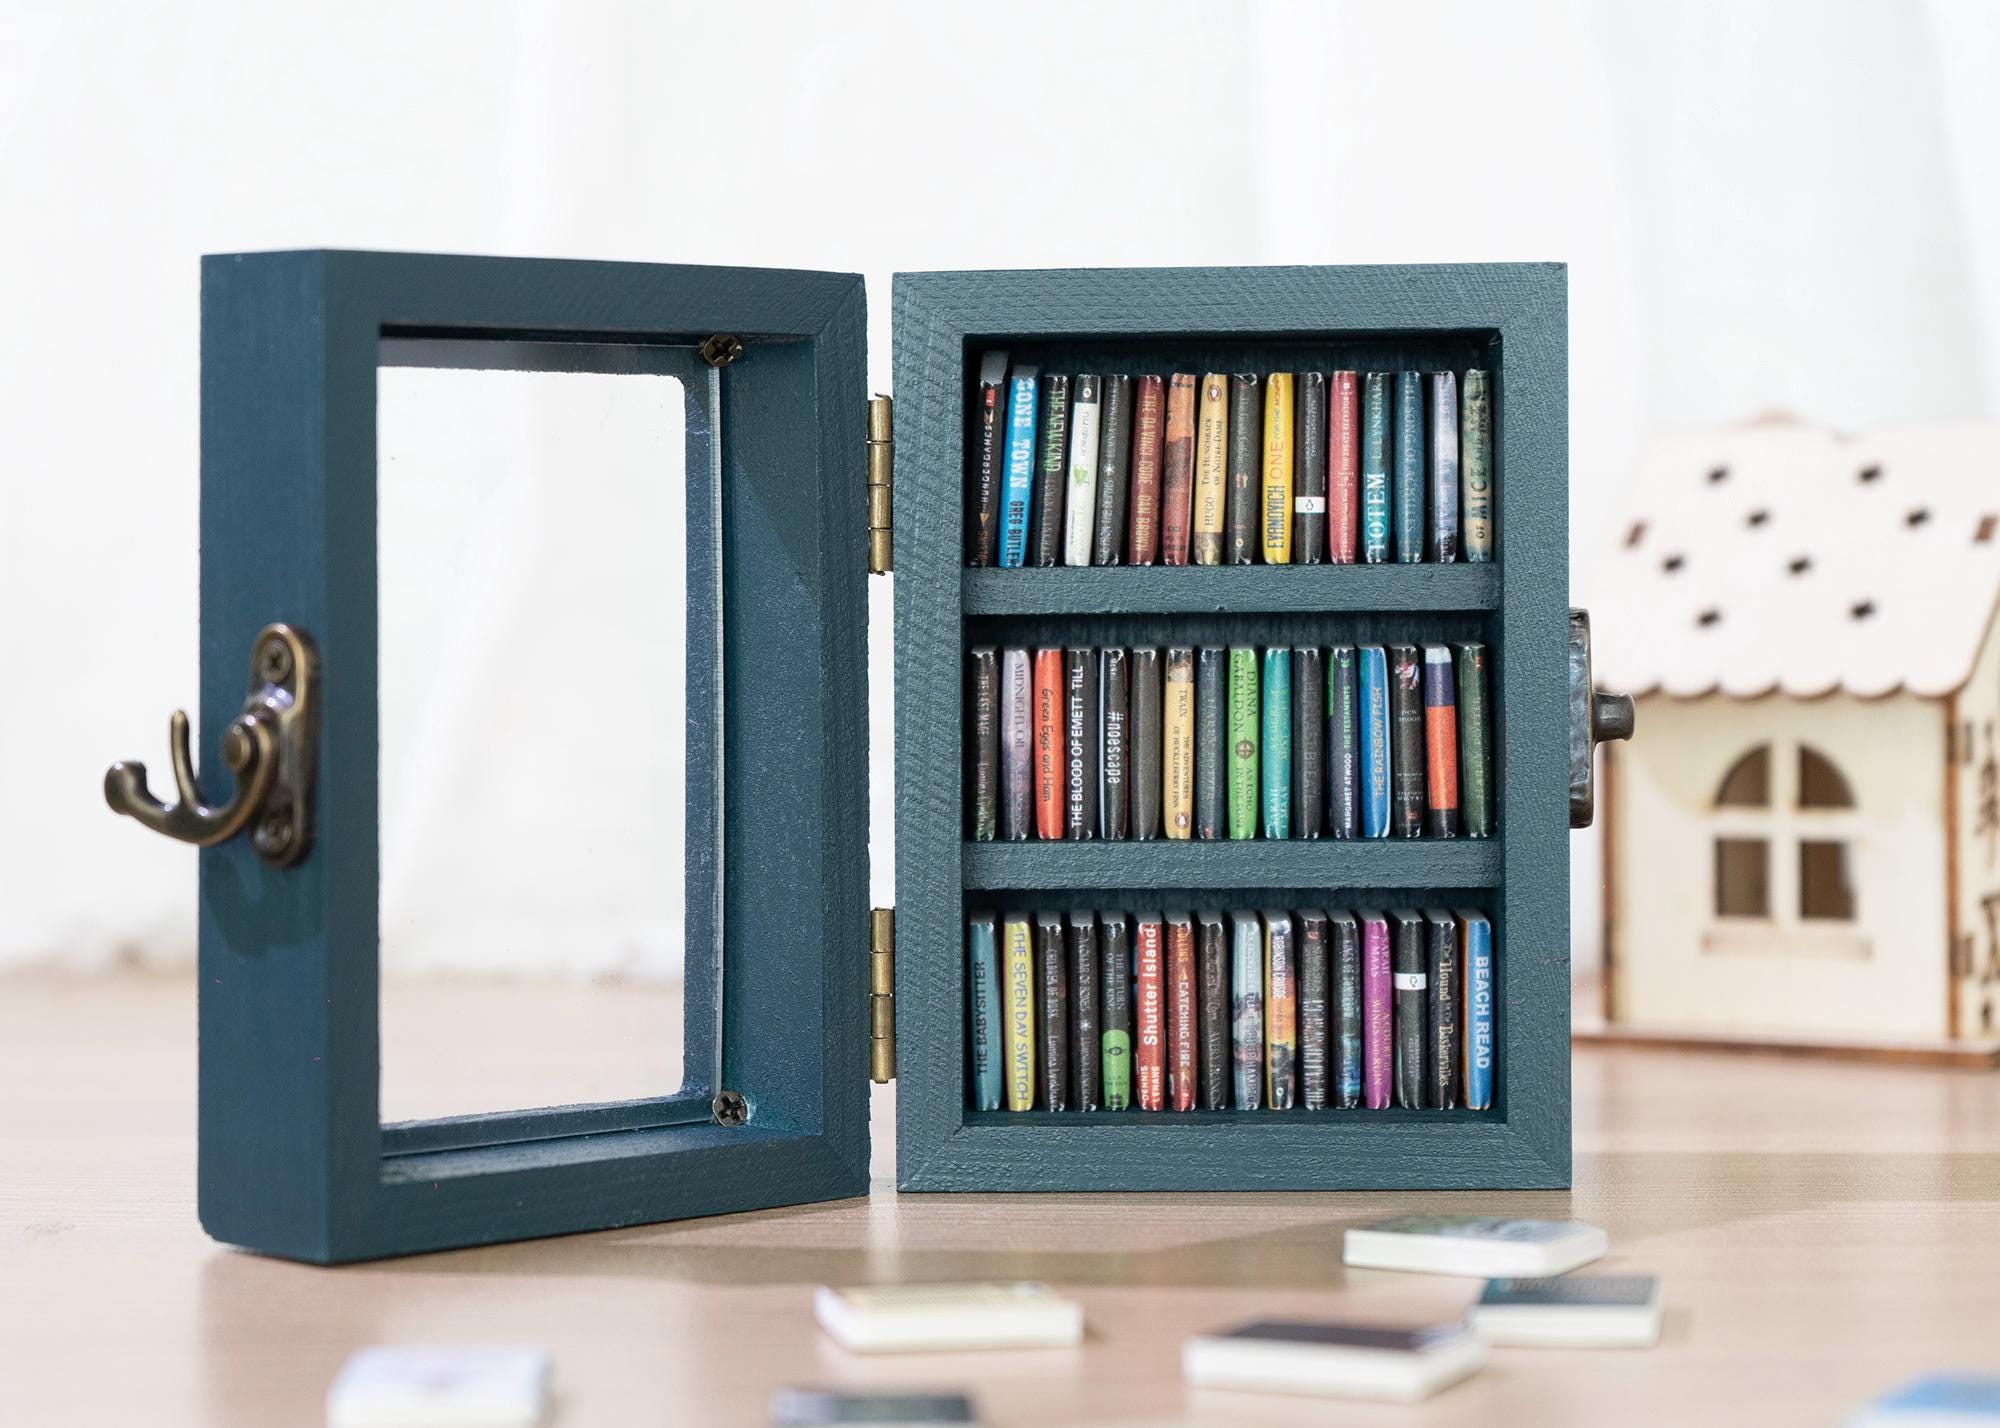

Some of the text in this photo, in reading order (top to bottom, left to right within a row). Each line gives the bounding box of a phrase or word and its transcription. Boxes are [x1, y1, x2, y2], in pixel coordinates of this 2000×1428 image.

[1050, 388, 1065, 411] THE
[1010, 378, 1035, 488] GONE TOWN
[1048, 414, 1064, 442] NEW
[1139, 394, 1156, 485] THE DA VINCI CODE
[1405, 408, 1415, 442] SONG
[1044, 443, 1063, 472] KIND
[1270, 442, 1283, 479] ONE
[1405, 447, 1415, 465] OF
[1205, 497, 1215, 526] HUGO
[1367, 472, 1385, 552] TOTEM
[1470, 466, 1487, 519] MICE
[1006, 501, 1024, 564] GREG BUTLER
[1135, 495, 1151, 551] DAN BROWN
[1267, 485, 1285, 548] EVANOVICH
[1476, 526, 1484, 539] OF
[978, 675, 989, 688] THE
[978, 692, 989, 711] LAST
[1179, 689, 1187, 718] TWAIN
[1233, 654, 1244, 733] GABALDON
[1247, 671, 1256, 717] DIANA
[1015, 663, 1025, 748] MIDNIGHT OIL
[1343, 685, 1351, 732] TESTAMENTS
[1040, 688, 1053, 801] Green Eggs and Ham
[1071, 666, 1083, 828] THE BLOOD OF EMETT TILL
[1105, 711, 1123, 784] #noescape
[1173, 726, 1179, 736] OF
[1372, 687, 1385, 797] THE RAINBOW FISH
[1344, 787, 1352, 828] MARGARET
[1273, 935, 1286, 971] ROBINSON
[1371, 945, 1380, 978] MAAS
[1381, 937, 1389, 974] SARAH
[1106, 953, 1115, 1011] OF THE KING
[1116, 953, 1125, 1010] THE RETURN
[1142, 927, 1158, 1046] Shutter Island
[1273, 972, 1287, 1000] CRUSOE
[1439, 960, 1453, 1001] Hound
[975, 962, 987, 1075] THE BABYSITTER
[1013, 931, 1028, 1100] THE SEVEN DAY SWITCH
[1179, 982, 1190, 1067] CATCHING FIRE
[1475, 956, 1490, 1069] BEACH READ
[1382, 1022, 1391, 1058] COURT
[1439, 1024, 1454, 1087] Baskervilles
[1141, 1065, 1149, 1101] DENNIS
[1152, 1065, 1160, 1102] LEHANE
